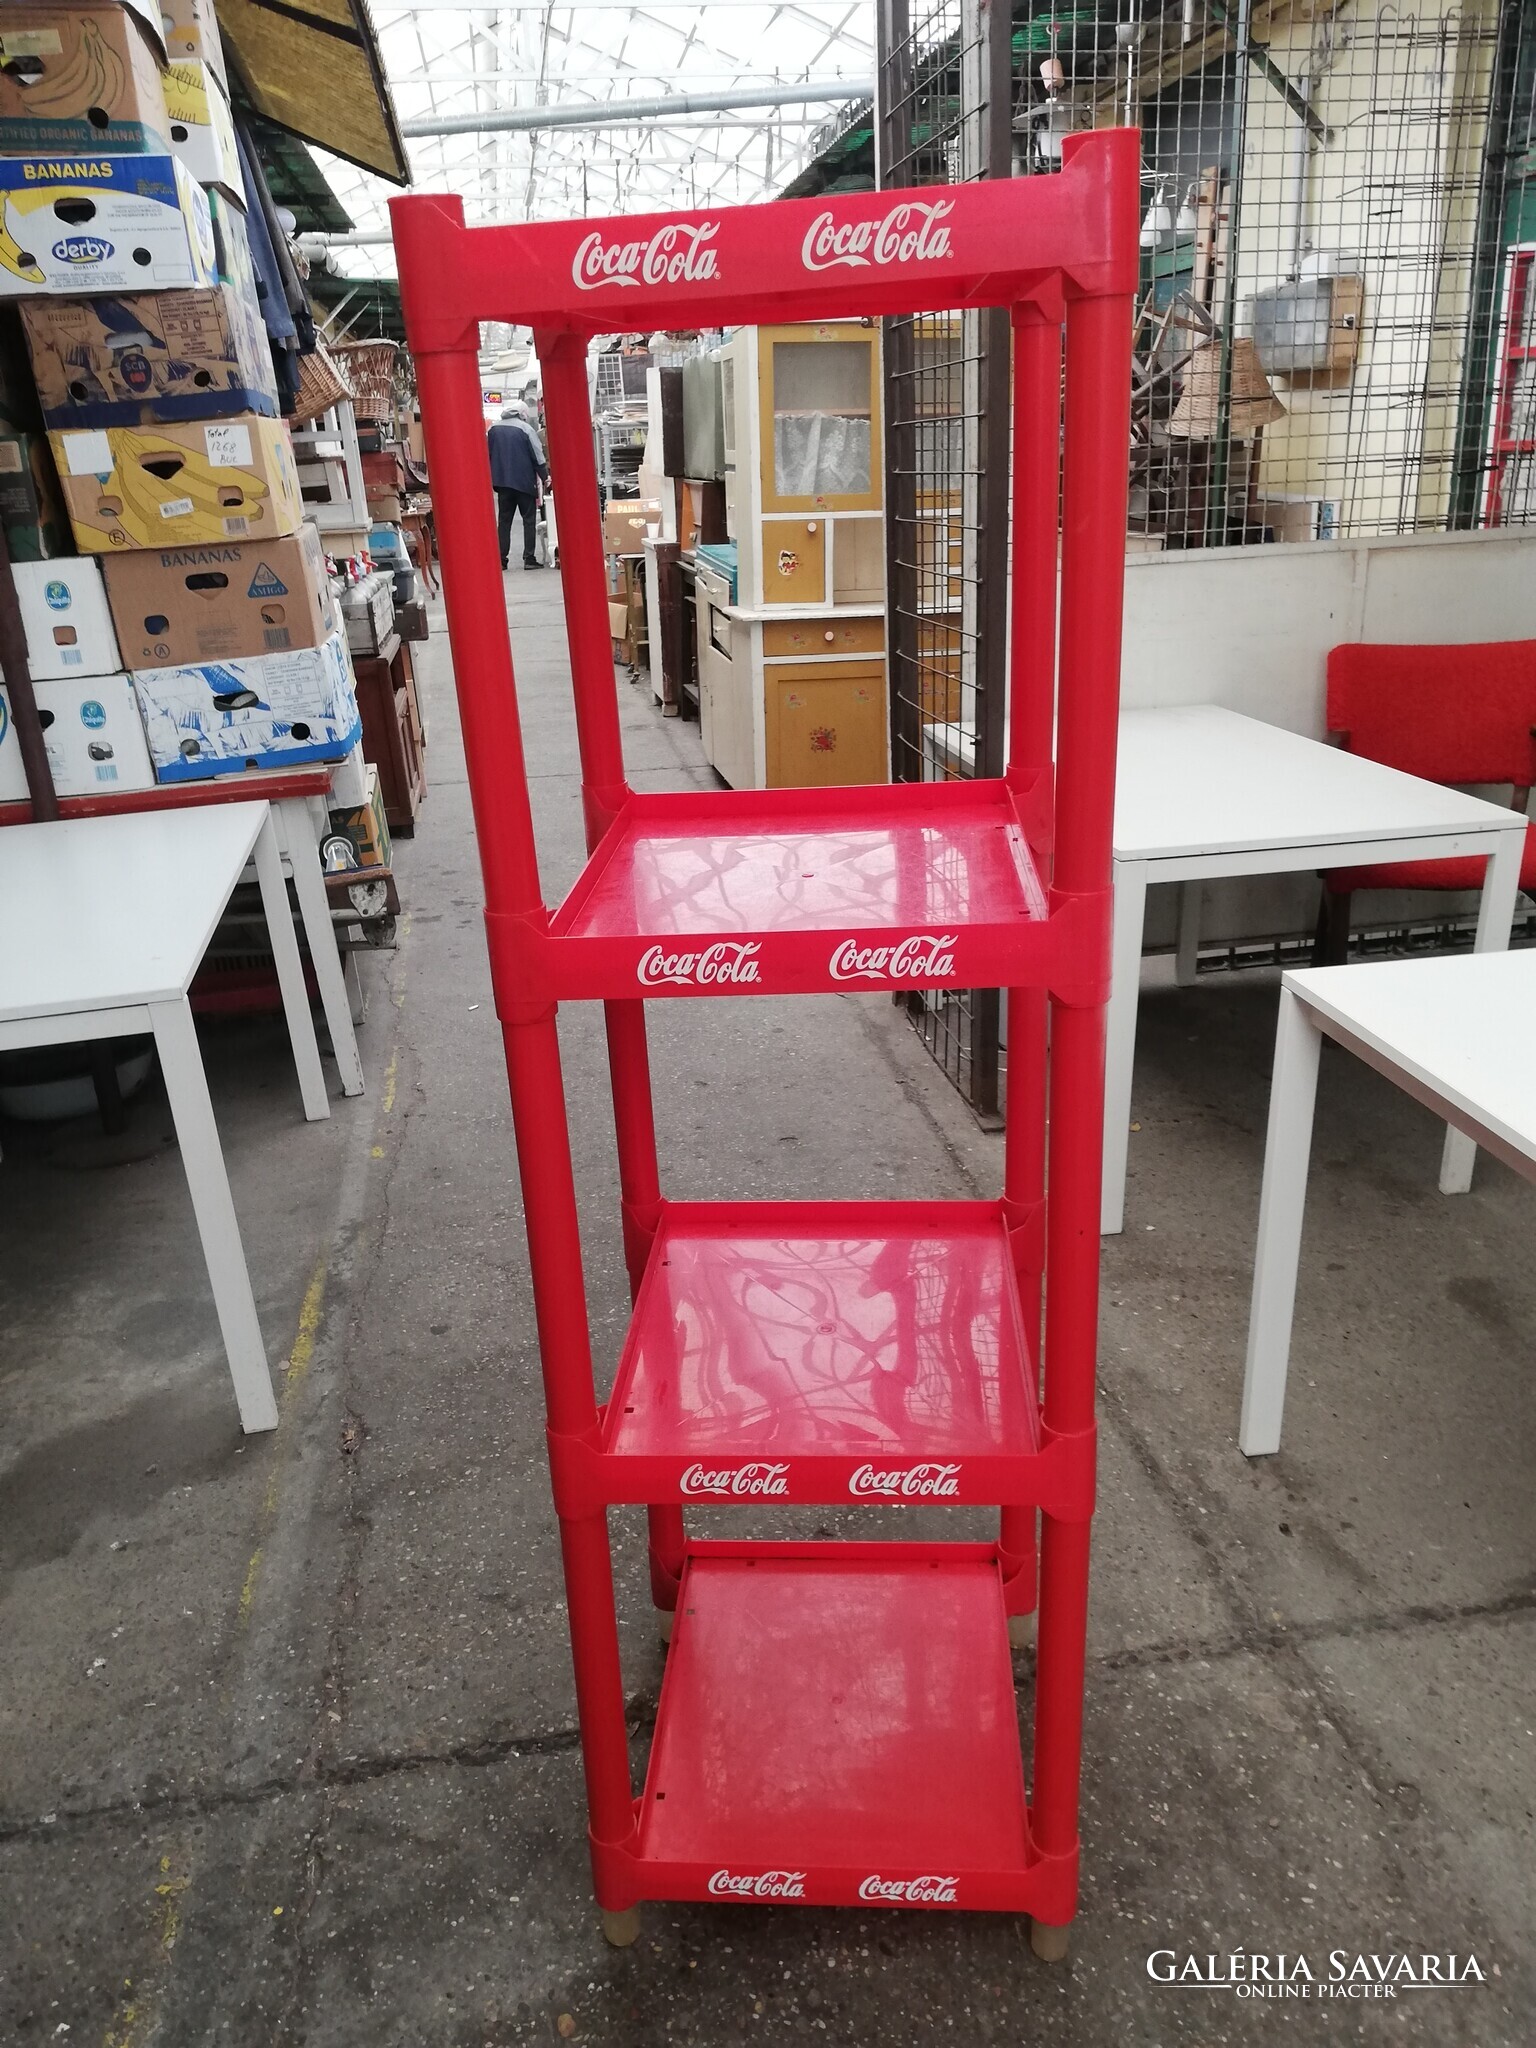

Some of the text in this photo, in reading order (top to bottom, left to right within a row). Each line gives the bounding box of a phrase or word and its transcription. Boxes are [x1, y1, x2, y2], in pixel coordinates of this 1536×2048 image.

[23, 162, 114, 180] BANANAS
[55, 239, 111, 262] derby
[211, 441, 237, 454] 1268
[160, 547, 242, 568] BANANAS
[251, 585, 286, 597] AMIGO
